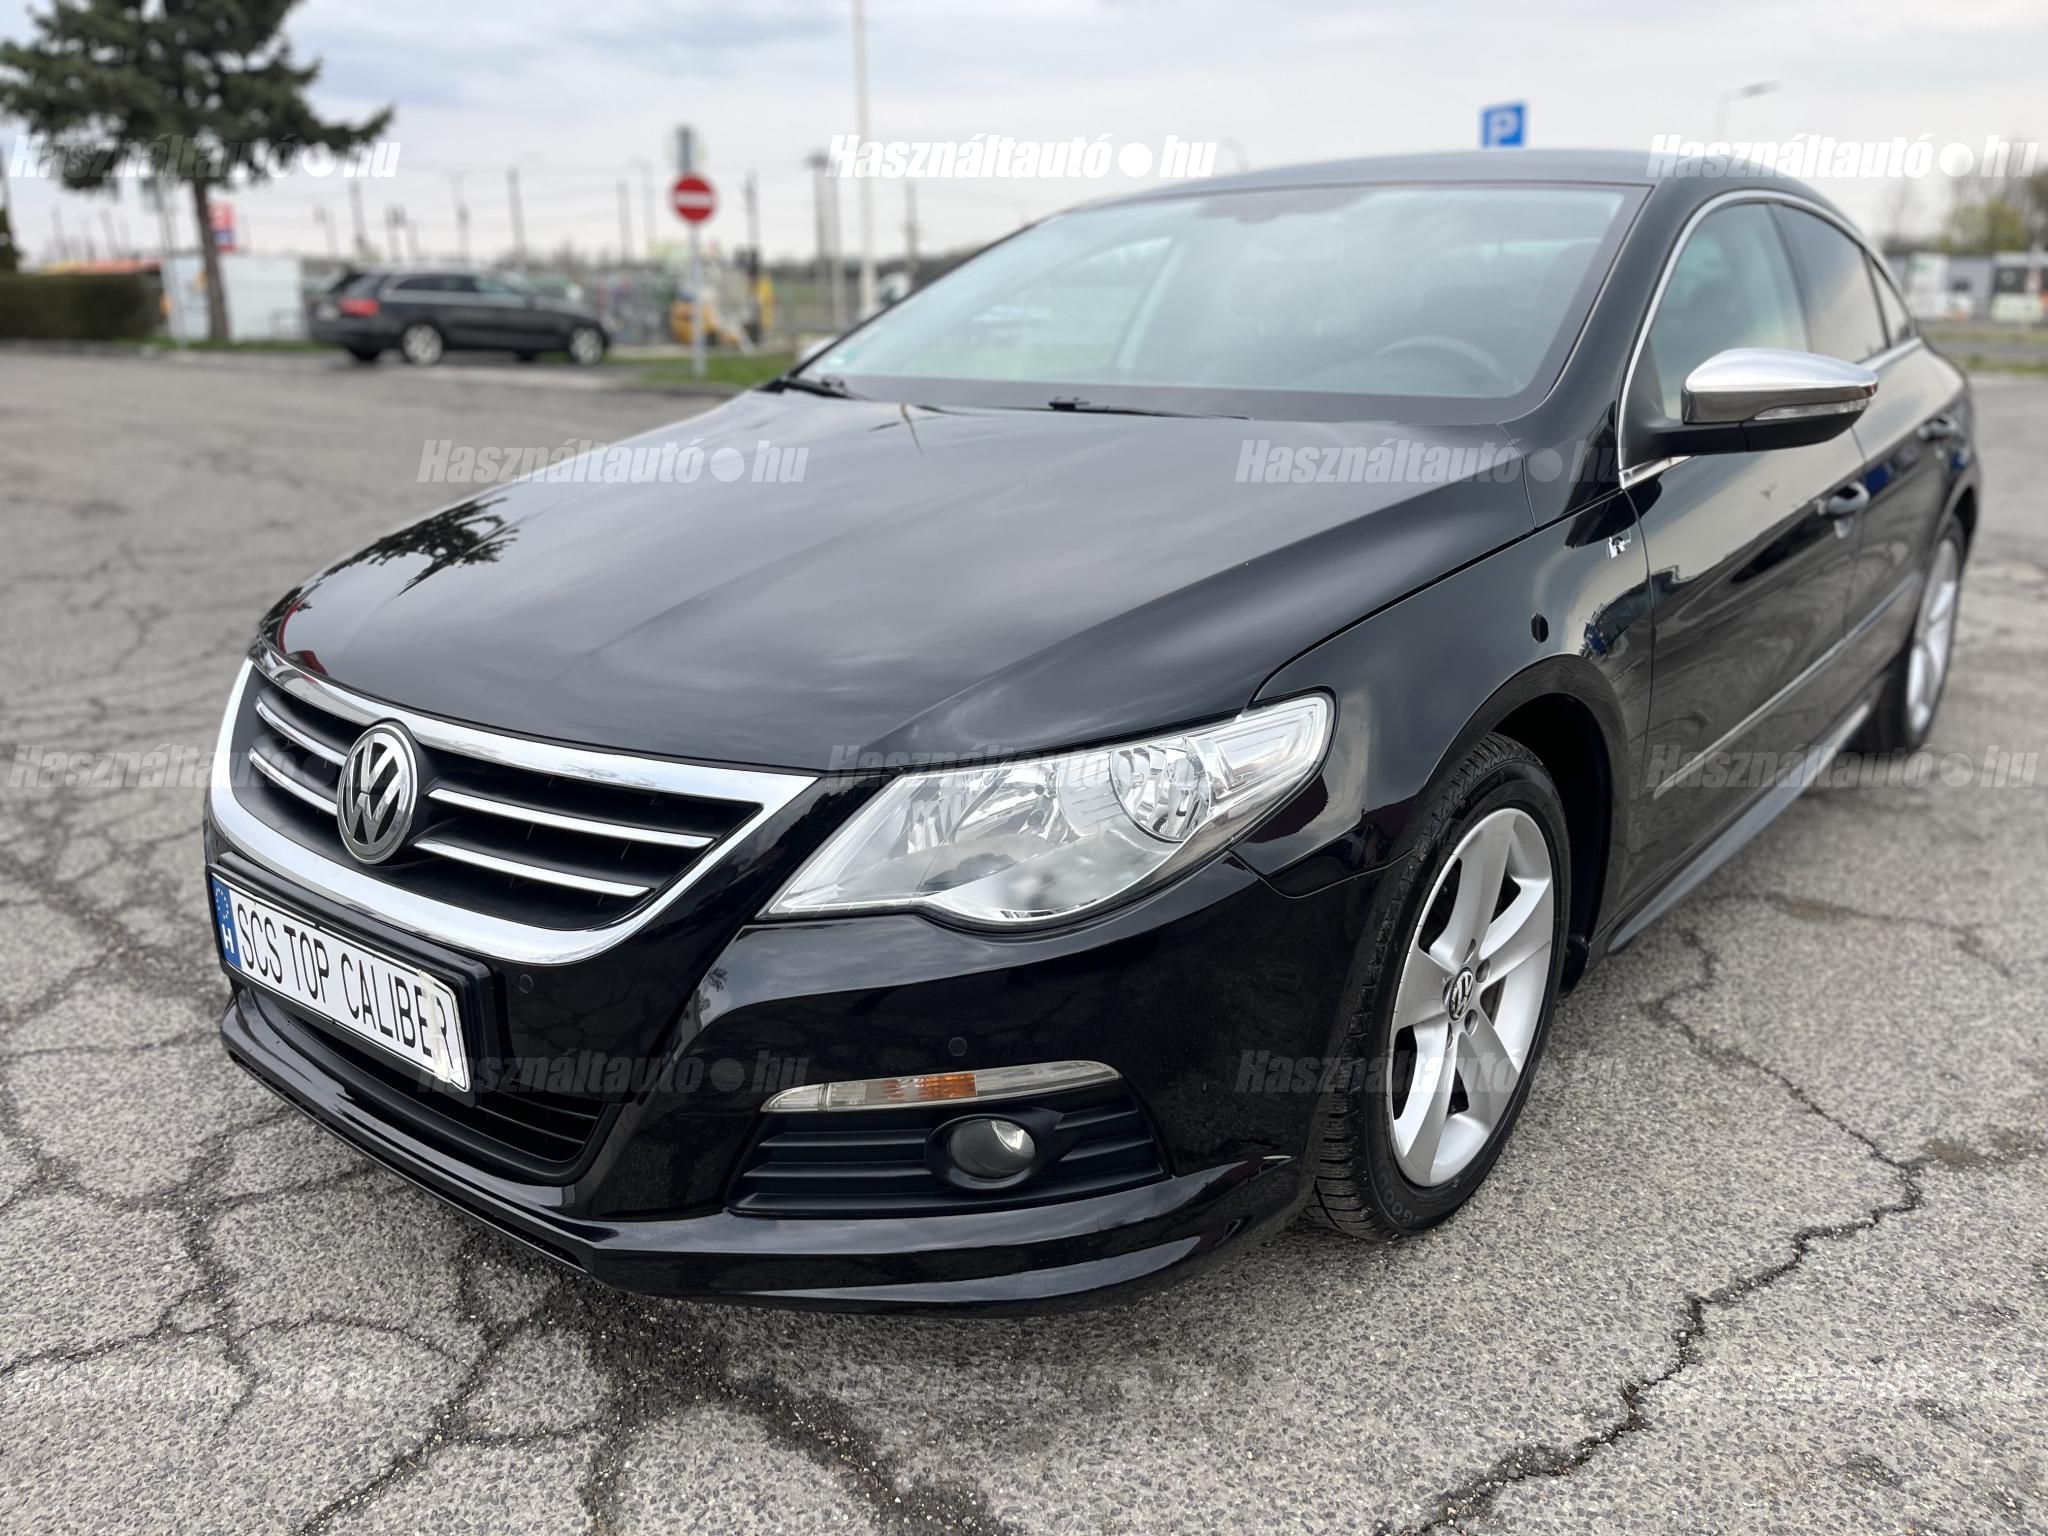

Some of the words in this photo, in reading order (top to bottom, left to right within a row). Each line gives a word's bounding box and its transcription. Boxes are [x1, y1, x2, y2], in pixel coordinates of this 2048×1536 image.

[1490, 112, 1517, 146] P
[222, 924, 235, 954] H
[237, 903, 283, 984] SCS
[283, 924, 330, 1003] TOP
